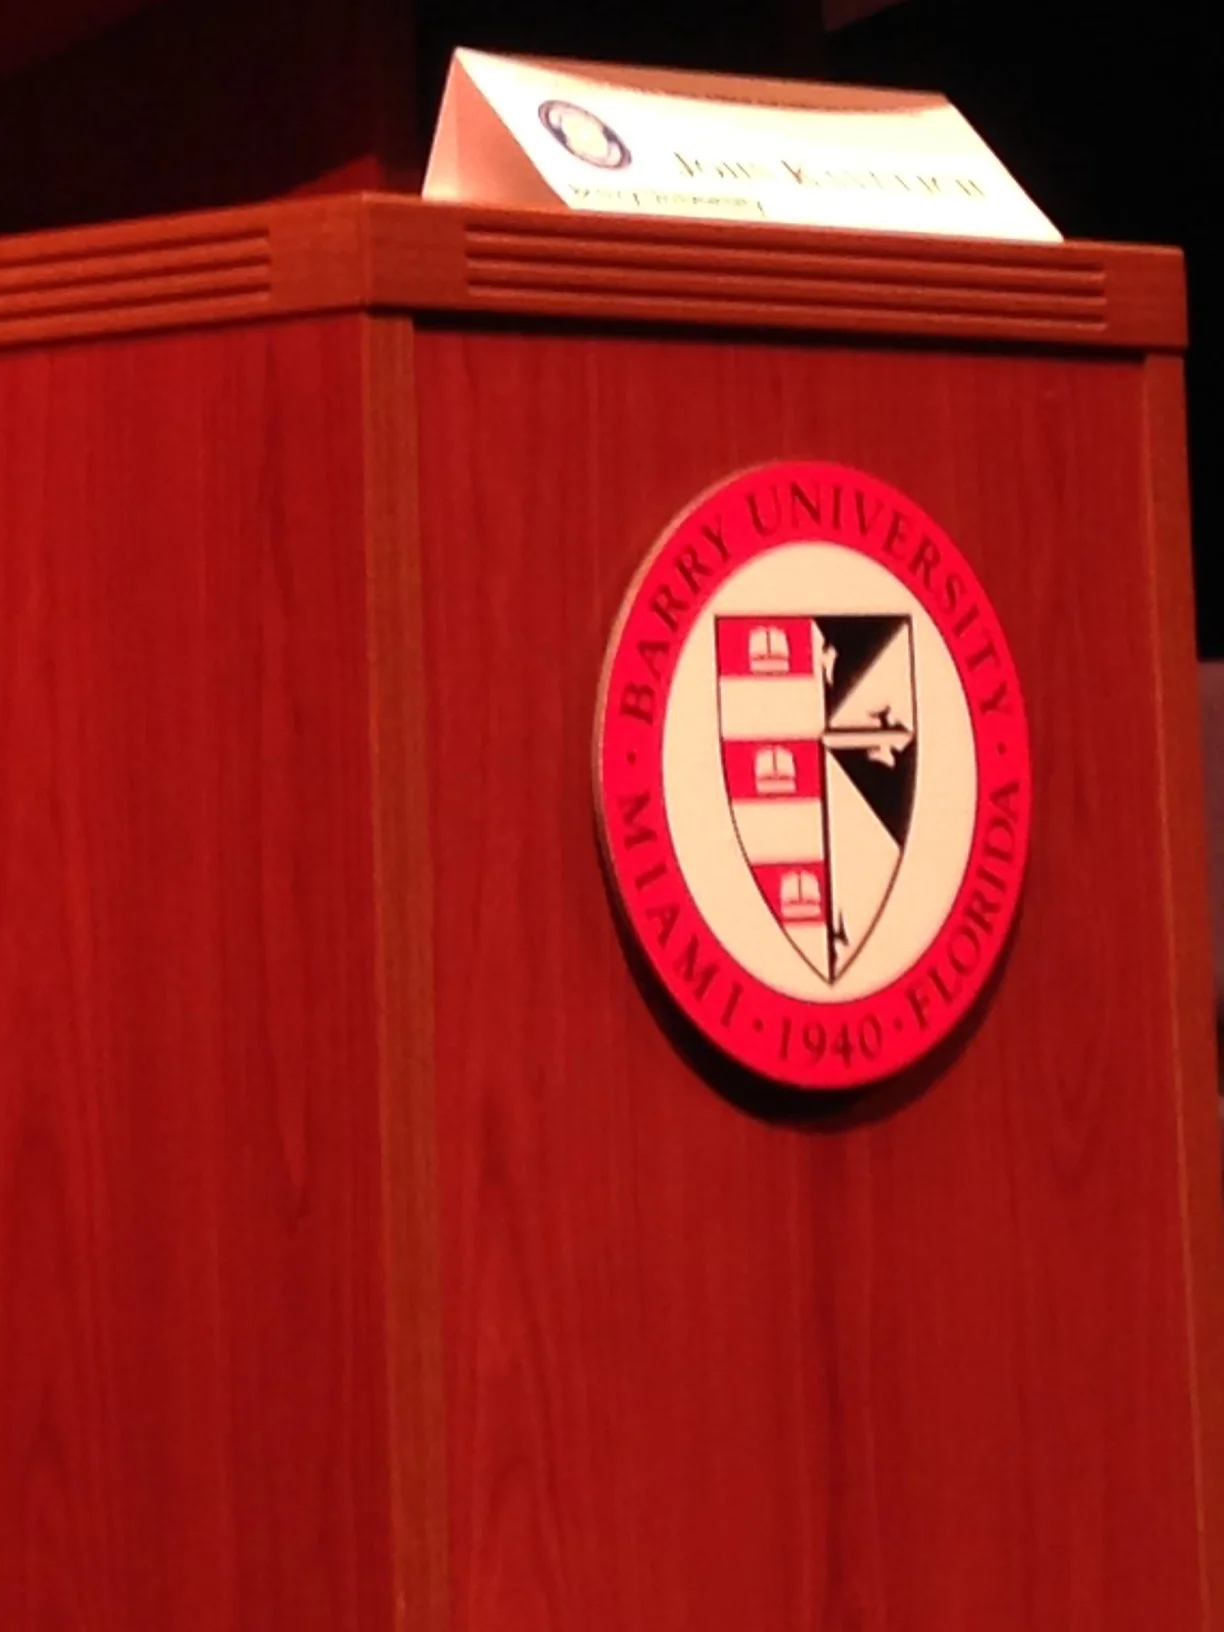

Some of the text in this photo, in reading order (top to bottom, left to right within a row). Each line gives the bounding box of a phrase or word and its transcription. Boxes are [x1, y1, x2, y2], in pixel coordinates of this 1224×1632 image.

[619, 480, 1013, 727] BARRY UNIVERSITY
[618, 780, 1021, 1069] MIAMI 1940 FLORIDA
